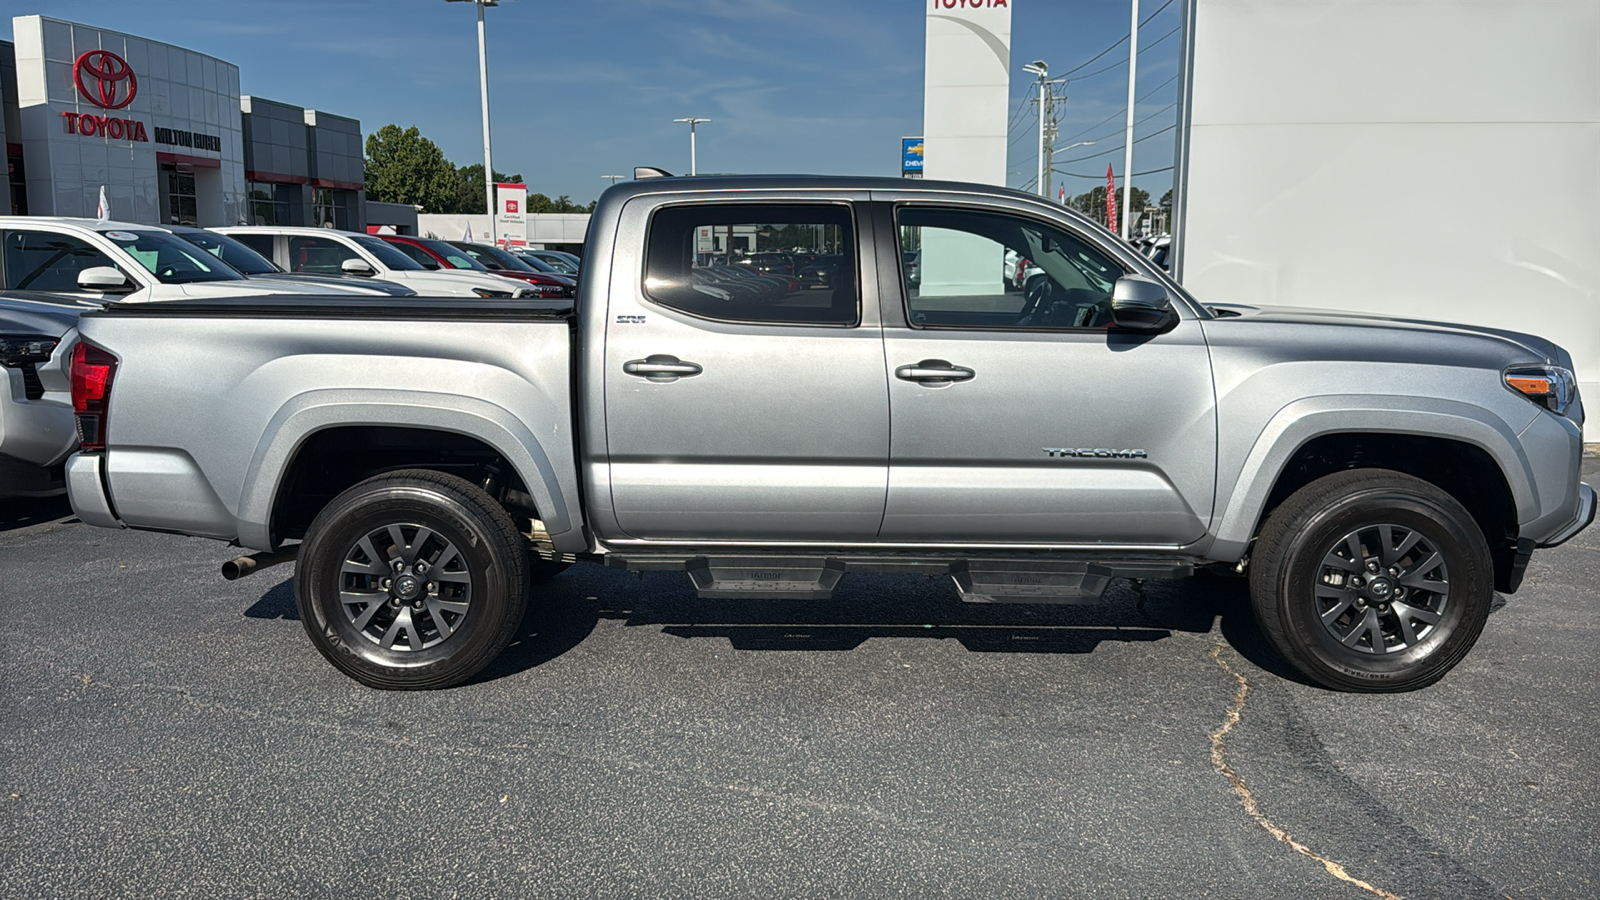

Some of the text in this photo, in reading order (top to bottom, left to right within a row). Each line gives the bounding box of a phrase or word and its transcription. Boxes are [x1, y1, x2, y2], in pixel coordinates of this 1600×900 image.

[933, 0, 1007, 9] TOYOTA
[63, 111, 149, 143] TOYOTA
[154, 126, 221, 152] MILTON RUBEN
[616, 315, 646, 324] SR5
[1042, 447, 1148, 459] TACOMA
